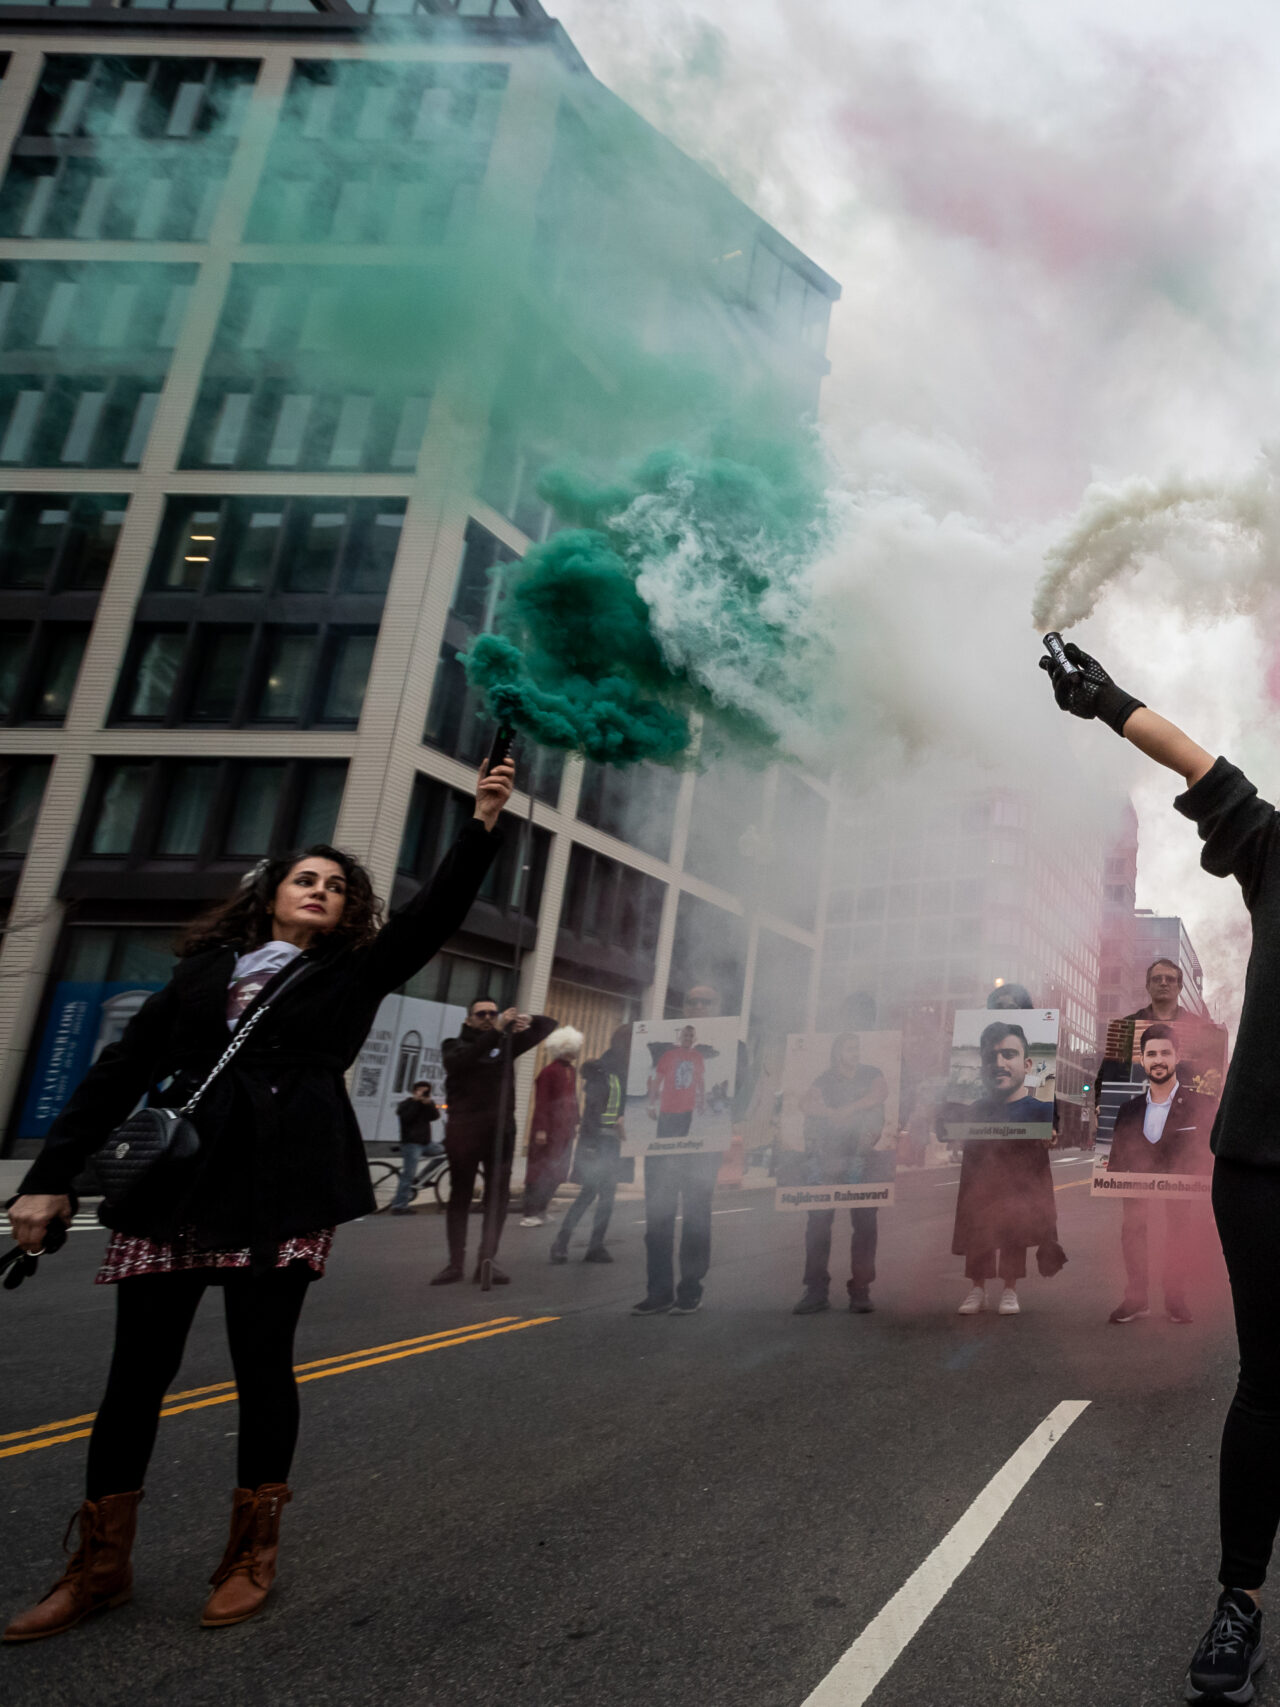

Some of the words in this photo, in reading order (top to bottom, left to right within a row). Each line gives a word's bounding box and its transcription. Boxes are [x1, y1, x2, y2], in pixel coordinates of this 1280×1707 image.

[1093, 1178, 1155, 1190] Mohammad
[781, 1191, 831, 1206] Majidreza
[834, 1188, 889, 1202] Rahnavard
